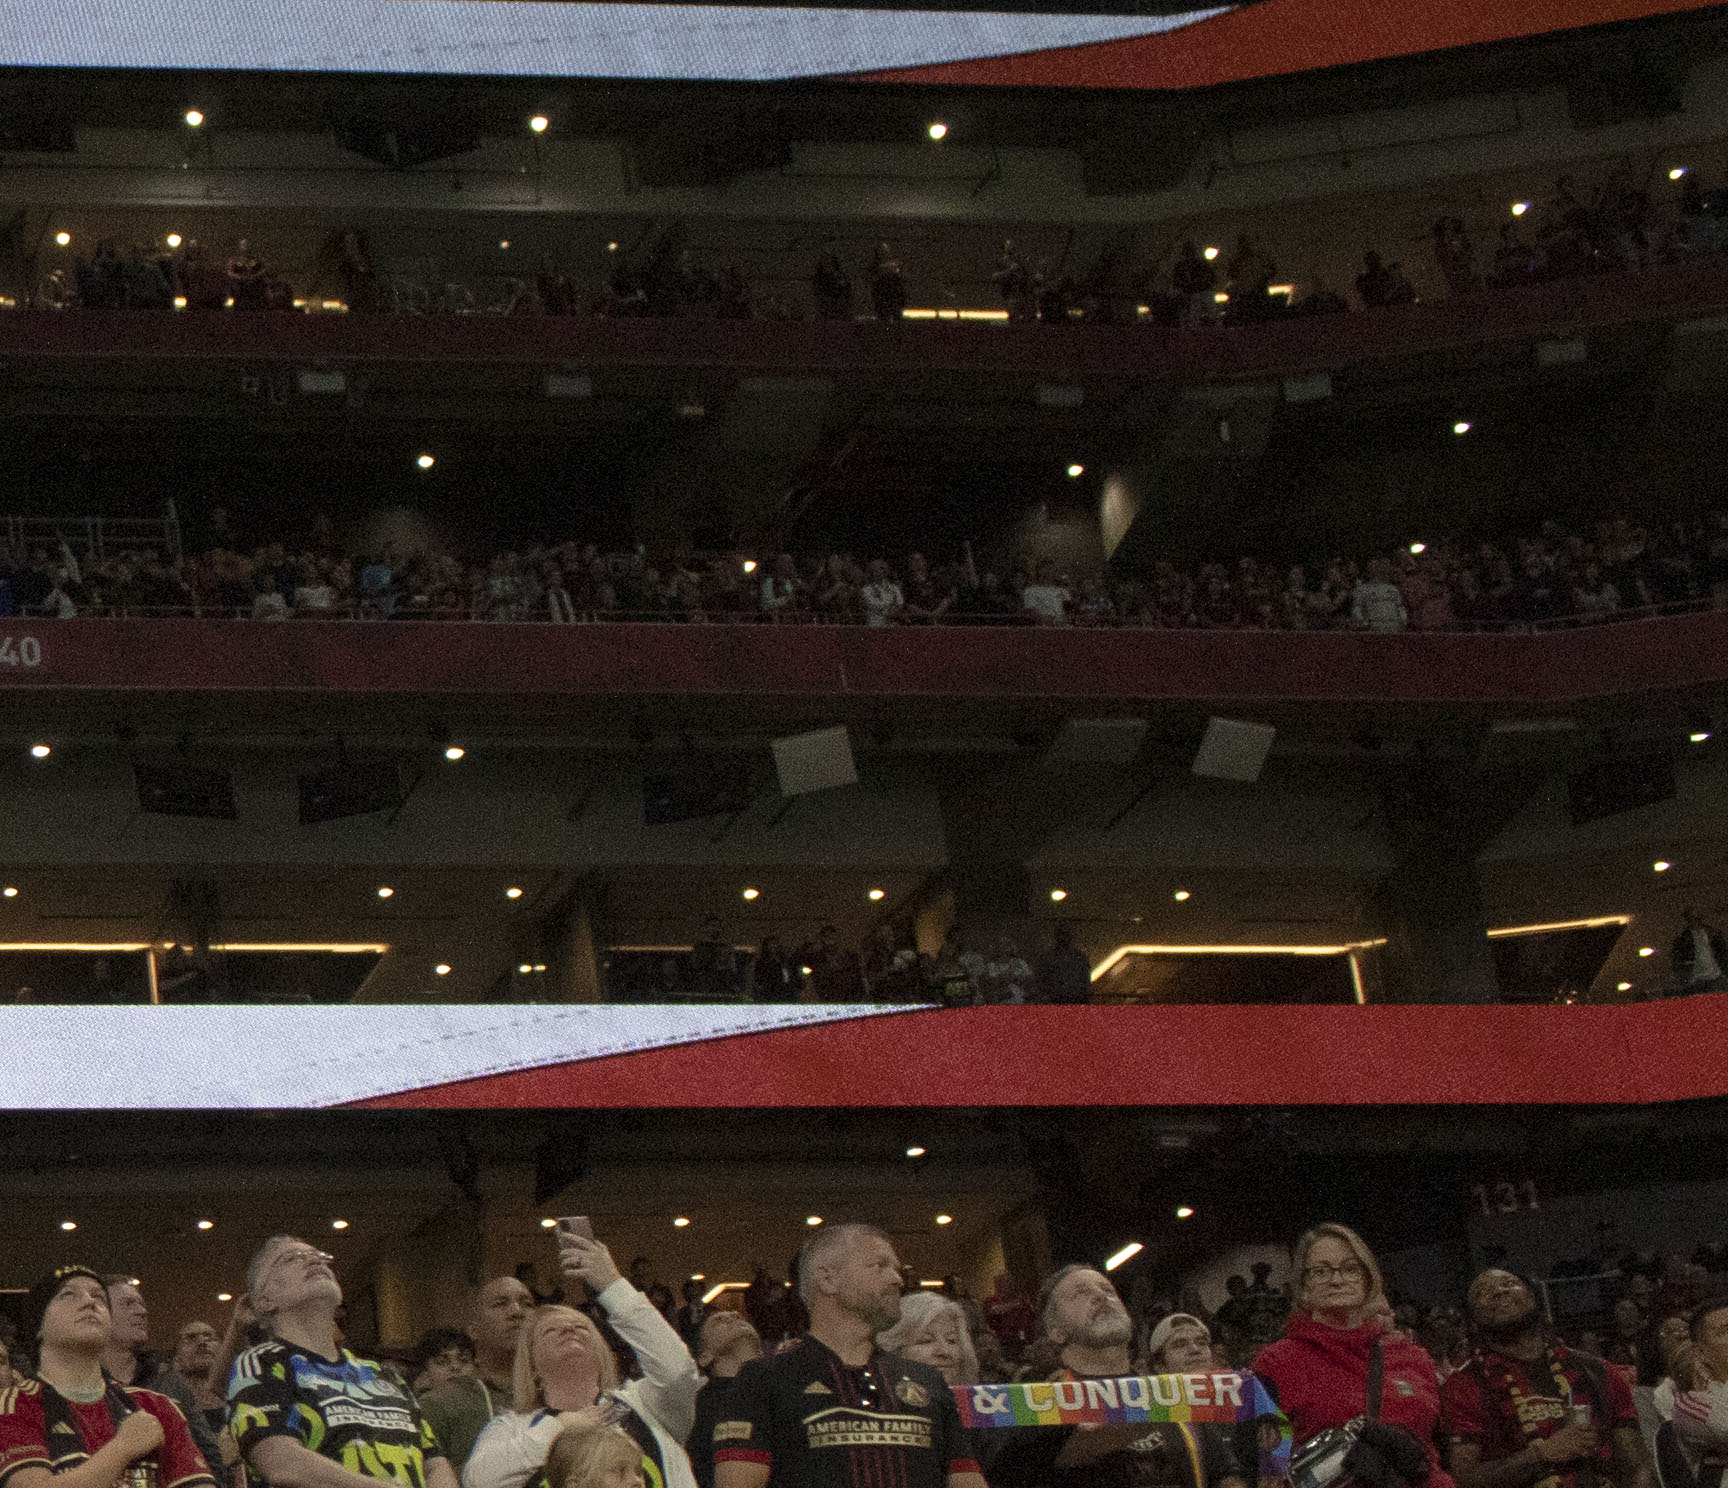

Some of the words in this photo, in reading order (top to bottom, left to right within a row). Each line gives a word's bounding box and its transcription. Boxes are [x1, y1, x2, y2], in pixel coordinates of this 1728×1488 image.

[973, 1385, 1010, 1414] &
[1022, 1373, 1243, 1411] CONQUER
[808, 1419, 880, 1434] AMERICAN
[883, 1421, 932, 1435] FAMILY
[819, 1434, 923, 1444] INSURANCE
